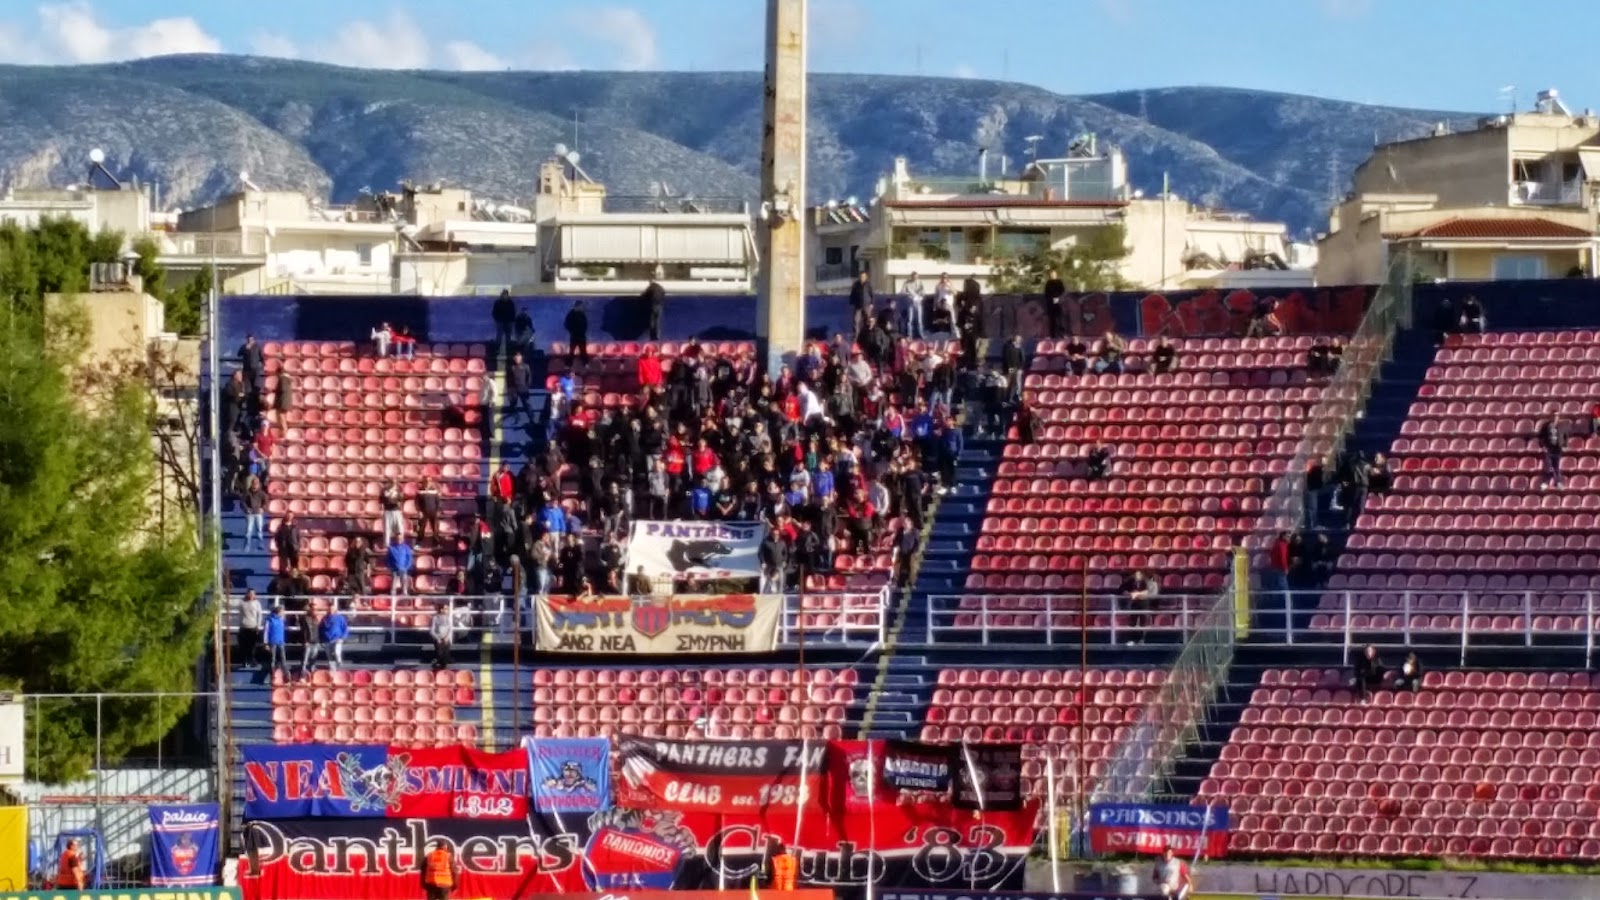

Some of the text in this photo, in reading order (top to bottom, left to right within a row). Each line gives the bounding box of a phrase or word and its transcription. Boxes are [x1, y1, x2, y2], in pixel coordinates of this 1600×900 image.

[646, 523, 755, 539] PANTHERS
[600, 634, 637, 651] ΝΕΑ
[675, 634, 746, 651] ΣΜΥΡΝΗ
[654, 742, 770, 769] PANTHERS
[244, 759, 528, 803] NEA SMIRNI
[664, 780, 722, 806] CLUB
[162, 808, 210, 826] palaio
[1100, 808, 1216, 827] PANIONIOS
[242, 817, 579, 878] Panthers
[704, 824, 886, 886] Club
